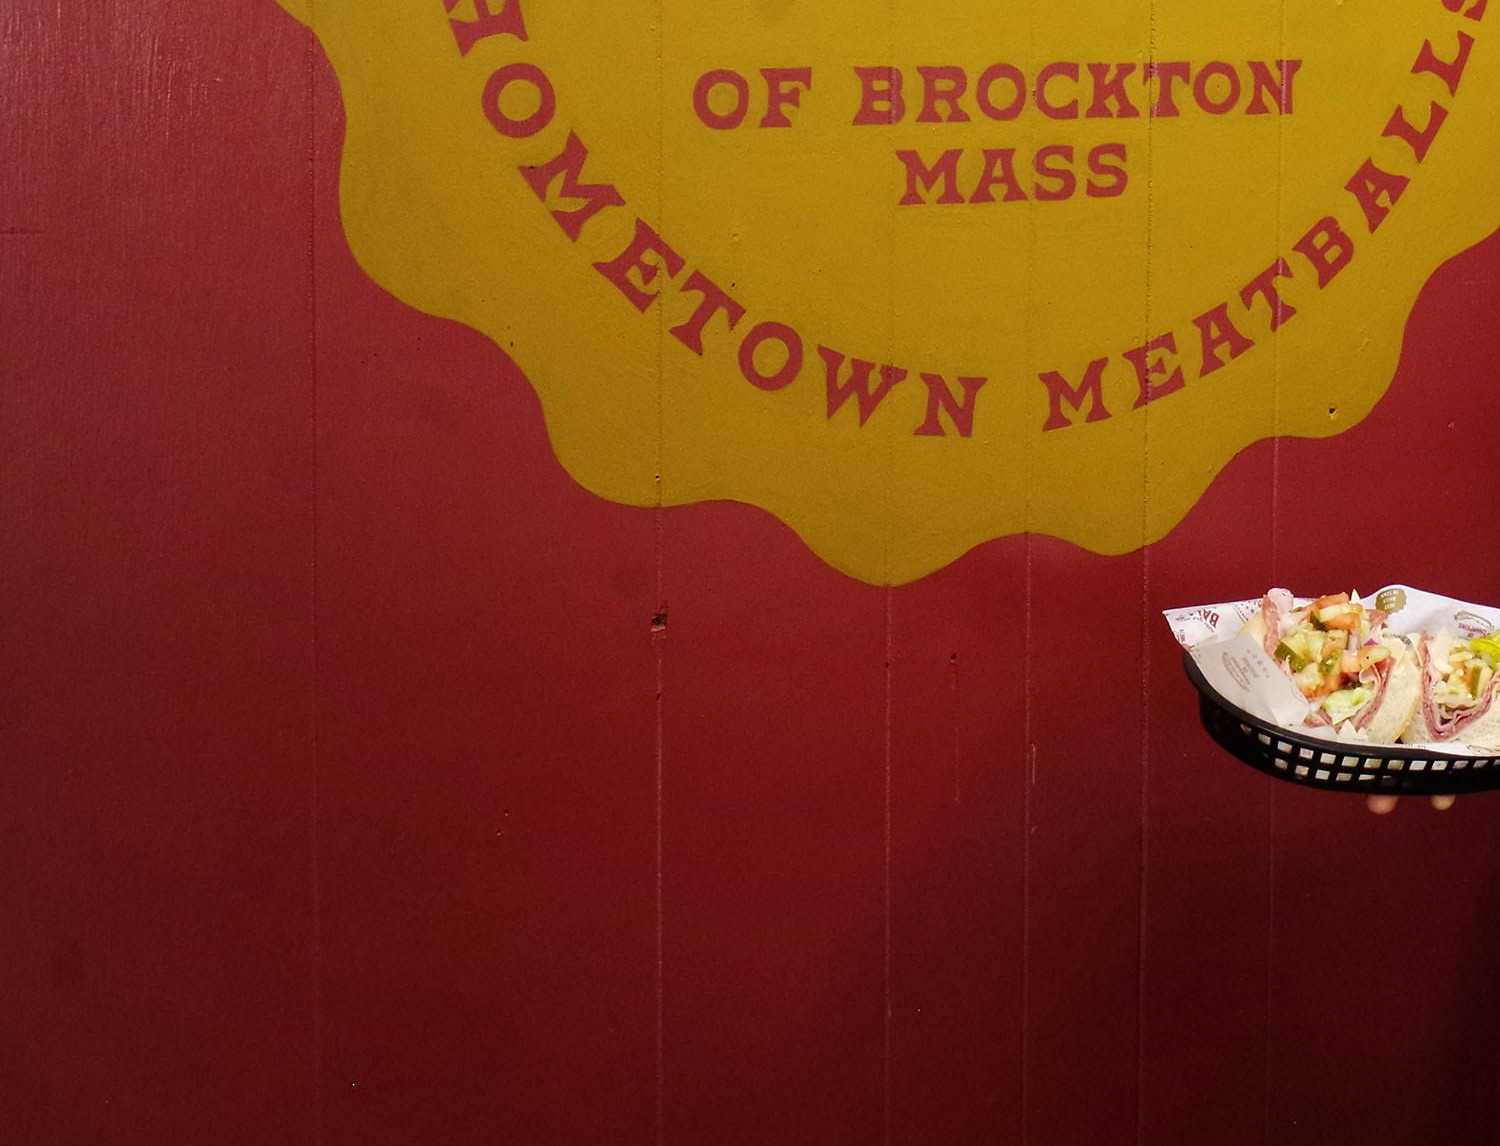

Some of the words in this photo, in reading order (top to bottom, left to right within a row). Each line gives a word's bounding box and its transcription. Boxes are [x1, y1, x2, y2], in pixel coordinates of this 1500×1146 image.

[692, 66, 814, 131] OF
[851, 59, 1303, 127] BROCKTON
[895, 142, 1130, 206] MASS
